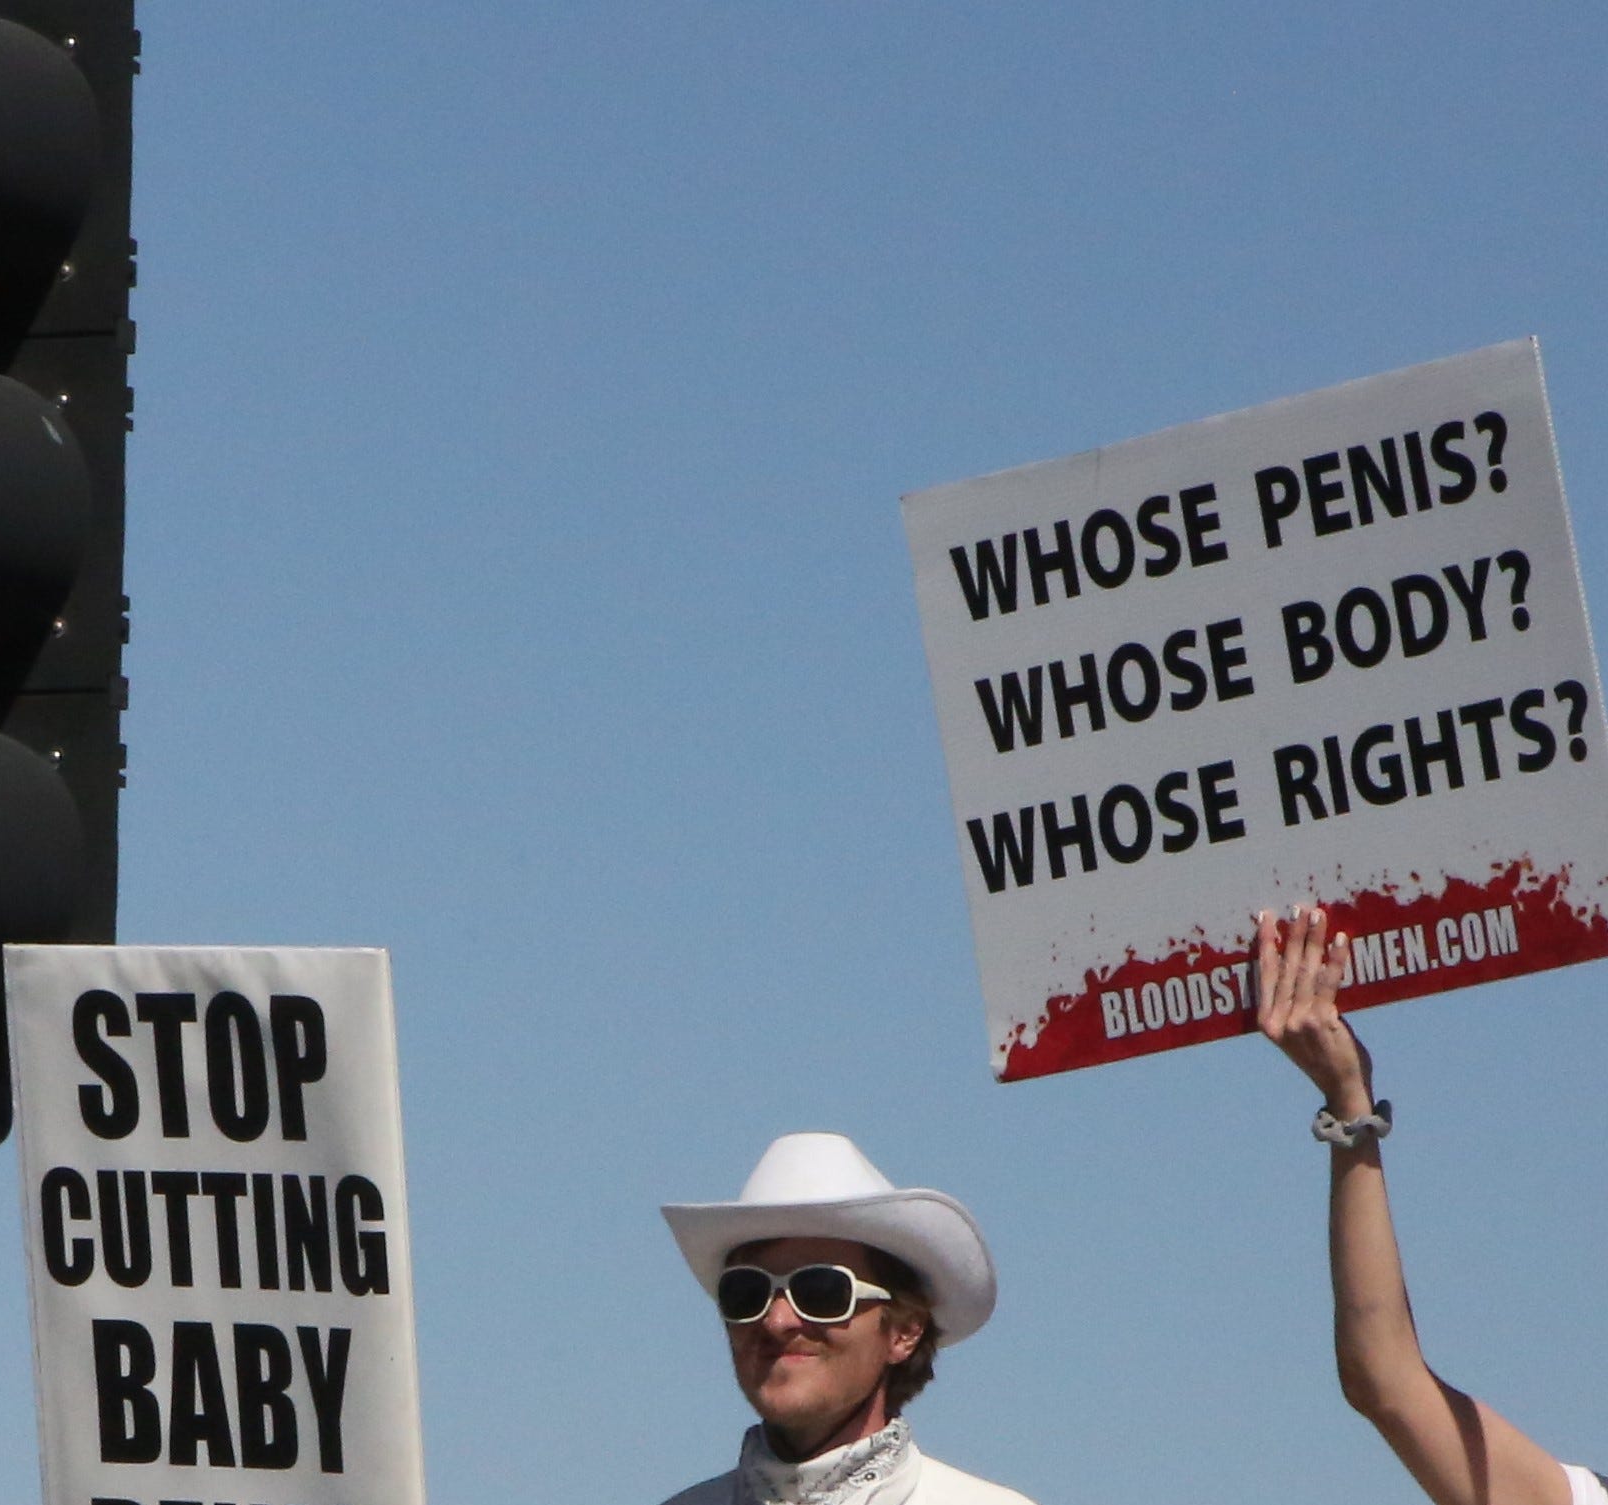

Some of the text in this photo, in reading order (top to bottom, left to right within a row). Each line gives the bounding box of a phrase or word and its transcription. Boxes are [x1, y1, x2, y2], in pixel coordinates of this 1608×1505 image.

[948, 410, 1509, 622] WHOSE PENIS?
[974, 549, 1532, 754] WHOSE BODY?
[965, 679, 1589, 894] WHOSE RIGHTS?
[72, 989, 328, 1143] STOP
[40, 1166, 390, 1297] CUTTING
[91, 1319, 352, 1474] BABY
